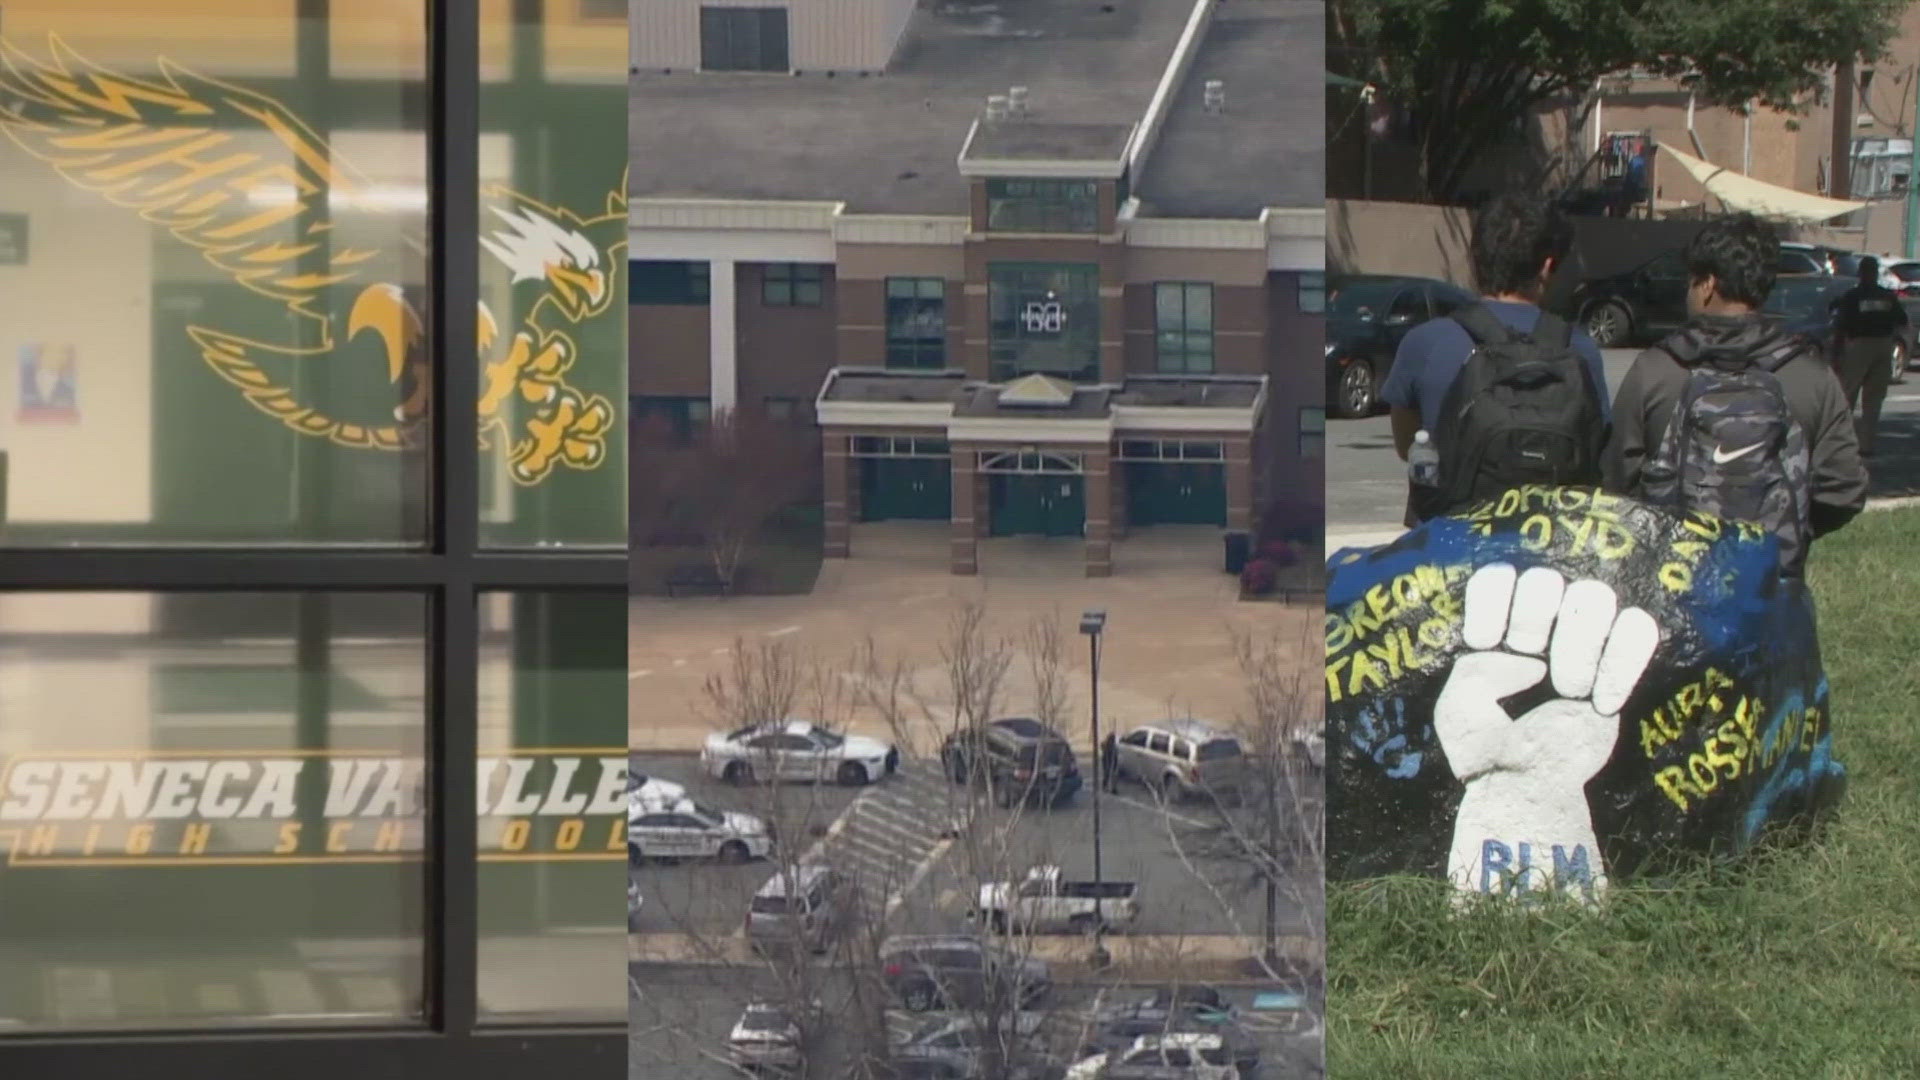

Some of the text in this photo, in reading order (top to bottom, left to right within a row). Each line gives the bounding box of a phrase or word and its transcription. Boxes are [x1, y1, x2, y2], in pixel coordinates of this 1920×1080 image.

[1325, 592, 1462, 702] TAYLOR
[0, 759, 304, 819] SENECA
[27, 823, 211, 856] HIGH
